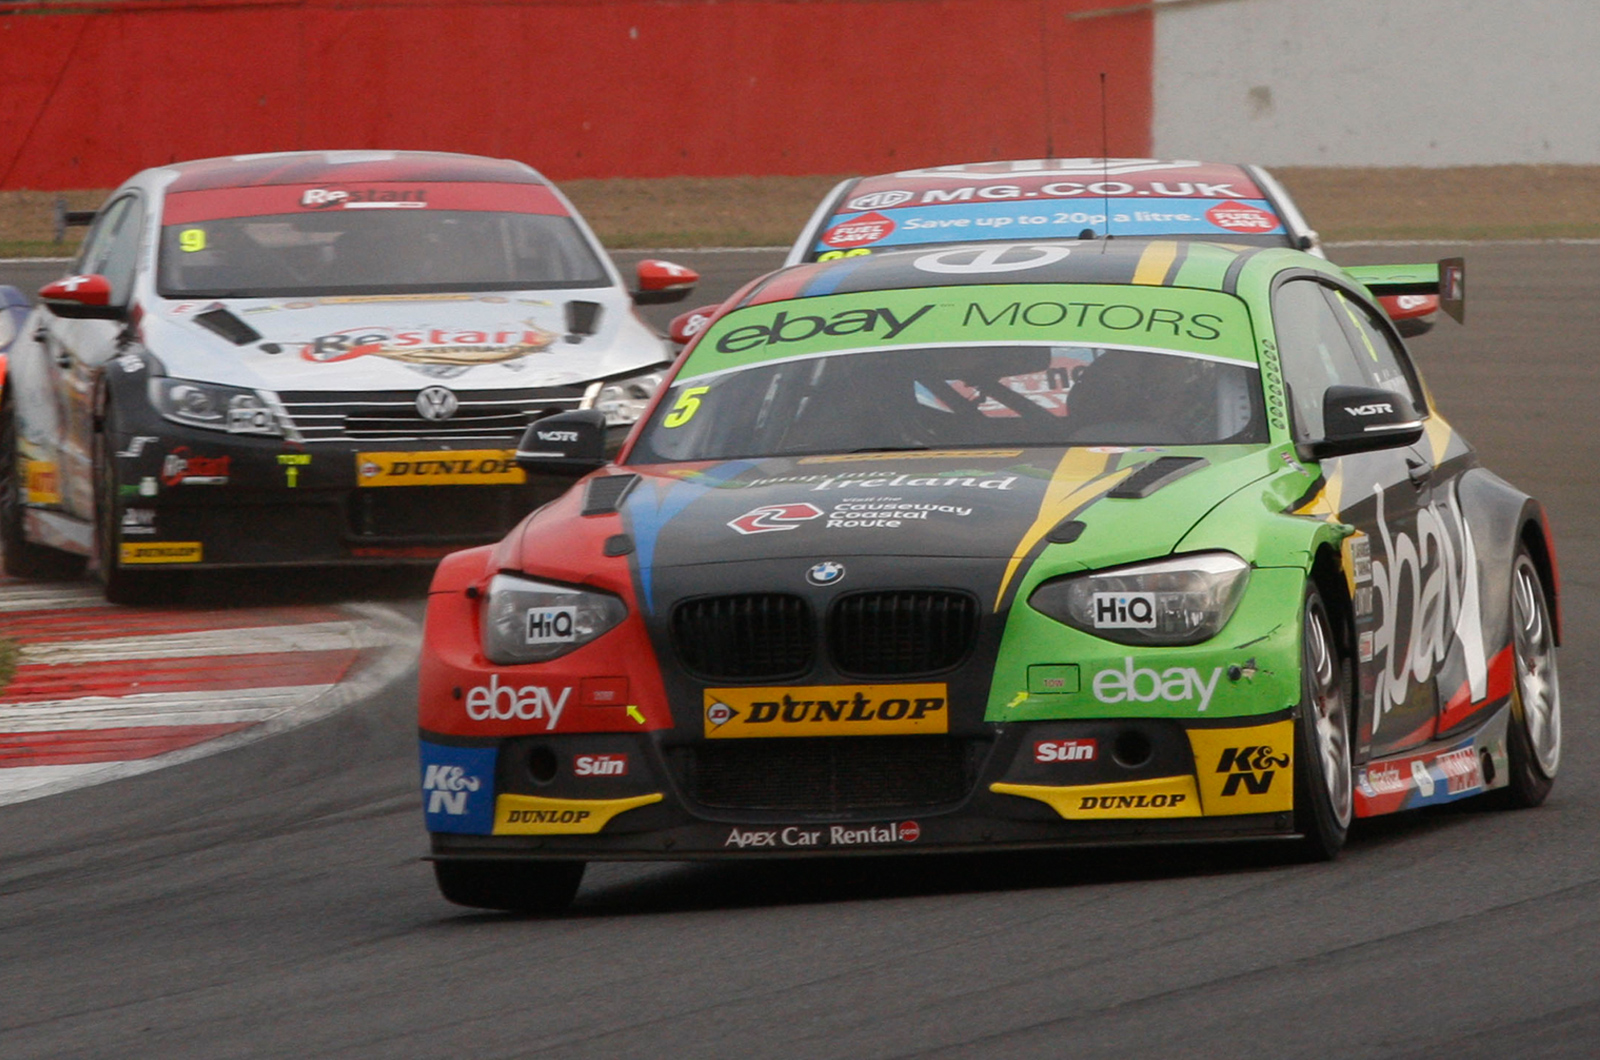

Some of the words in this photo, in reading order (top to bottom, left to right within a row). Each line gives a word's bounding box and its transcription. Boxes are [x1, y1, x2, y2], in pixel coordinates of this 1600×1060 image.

[920, 181, 1247, 204] MG.CO.UK
[902, 217, 970, 230] Save
[975, 215, 1012, 228] up
[1018, 214, 1047, 225] to
[1052, 212, 1107, 226] 20p
[1113, 212, 1131, 222] a
[1134, 210, 1200, 222] litre.
[180, 229, 206, 252] 9
[715, 303, 936, 354] ebay
[962, 301, 1224, 341] MOTORS
[663, 385, 710, 429] 5
[1344, 403, 1394, 416] WSR
[537, 430, 578, 442] WSR
[387, 458, 521, 475] DUNLOP
[809, 474, 1019, 492] Ireland
[829, 510, 928, 520] Coastal
[833, 502, 974, 516] Causeway
[825, 519, 902, 529] Route
[1097, 596, 1154, 625] HiQ
[528, 610, 574, 639] HiQ
[1093, 656, 1223, 712] ebay
[465, 674, 573, 730] ebay
[743, 697, 946, 724] DUNLOP
[1036, 743, 1094, 761] Sun
[1079, 793, 1186, 810] DUNLOP
[507, 809, 591, 824] DUNLOP
[781, 826, 821, 846] Car
